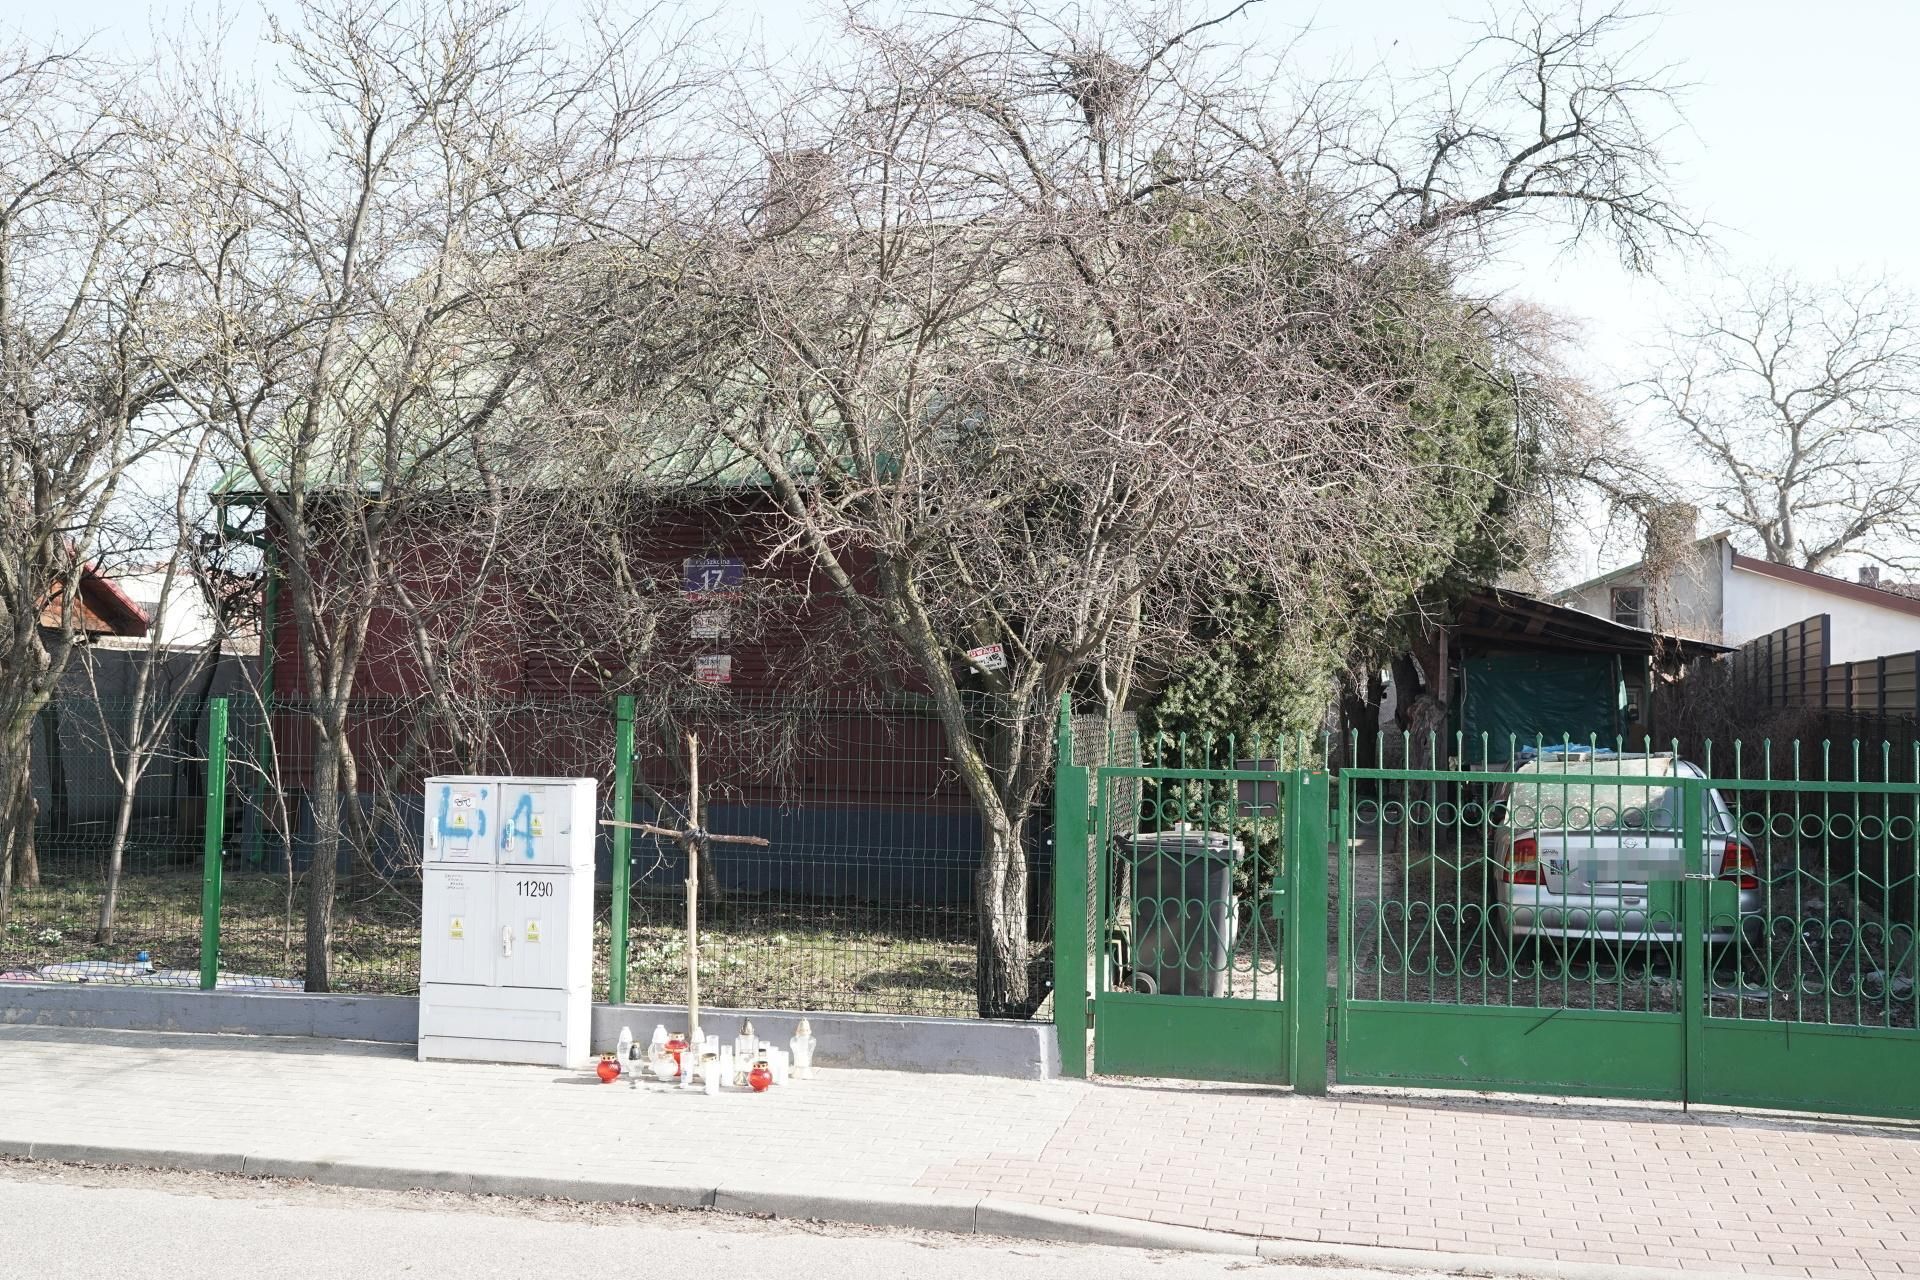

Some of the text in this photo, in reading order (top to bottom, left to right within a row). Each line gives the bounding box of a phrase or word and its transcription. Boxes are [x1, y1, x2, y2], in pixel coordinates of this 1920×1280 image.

[701, 570, 723, 590] 17
[970, 646, 1000, 657] UWAGA
[516, 881, 553, 898] 11290
